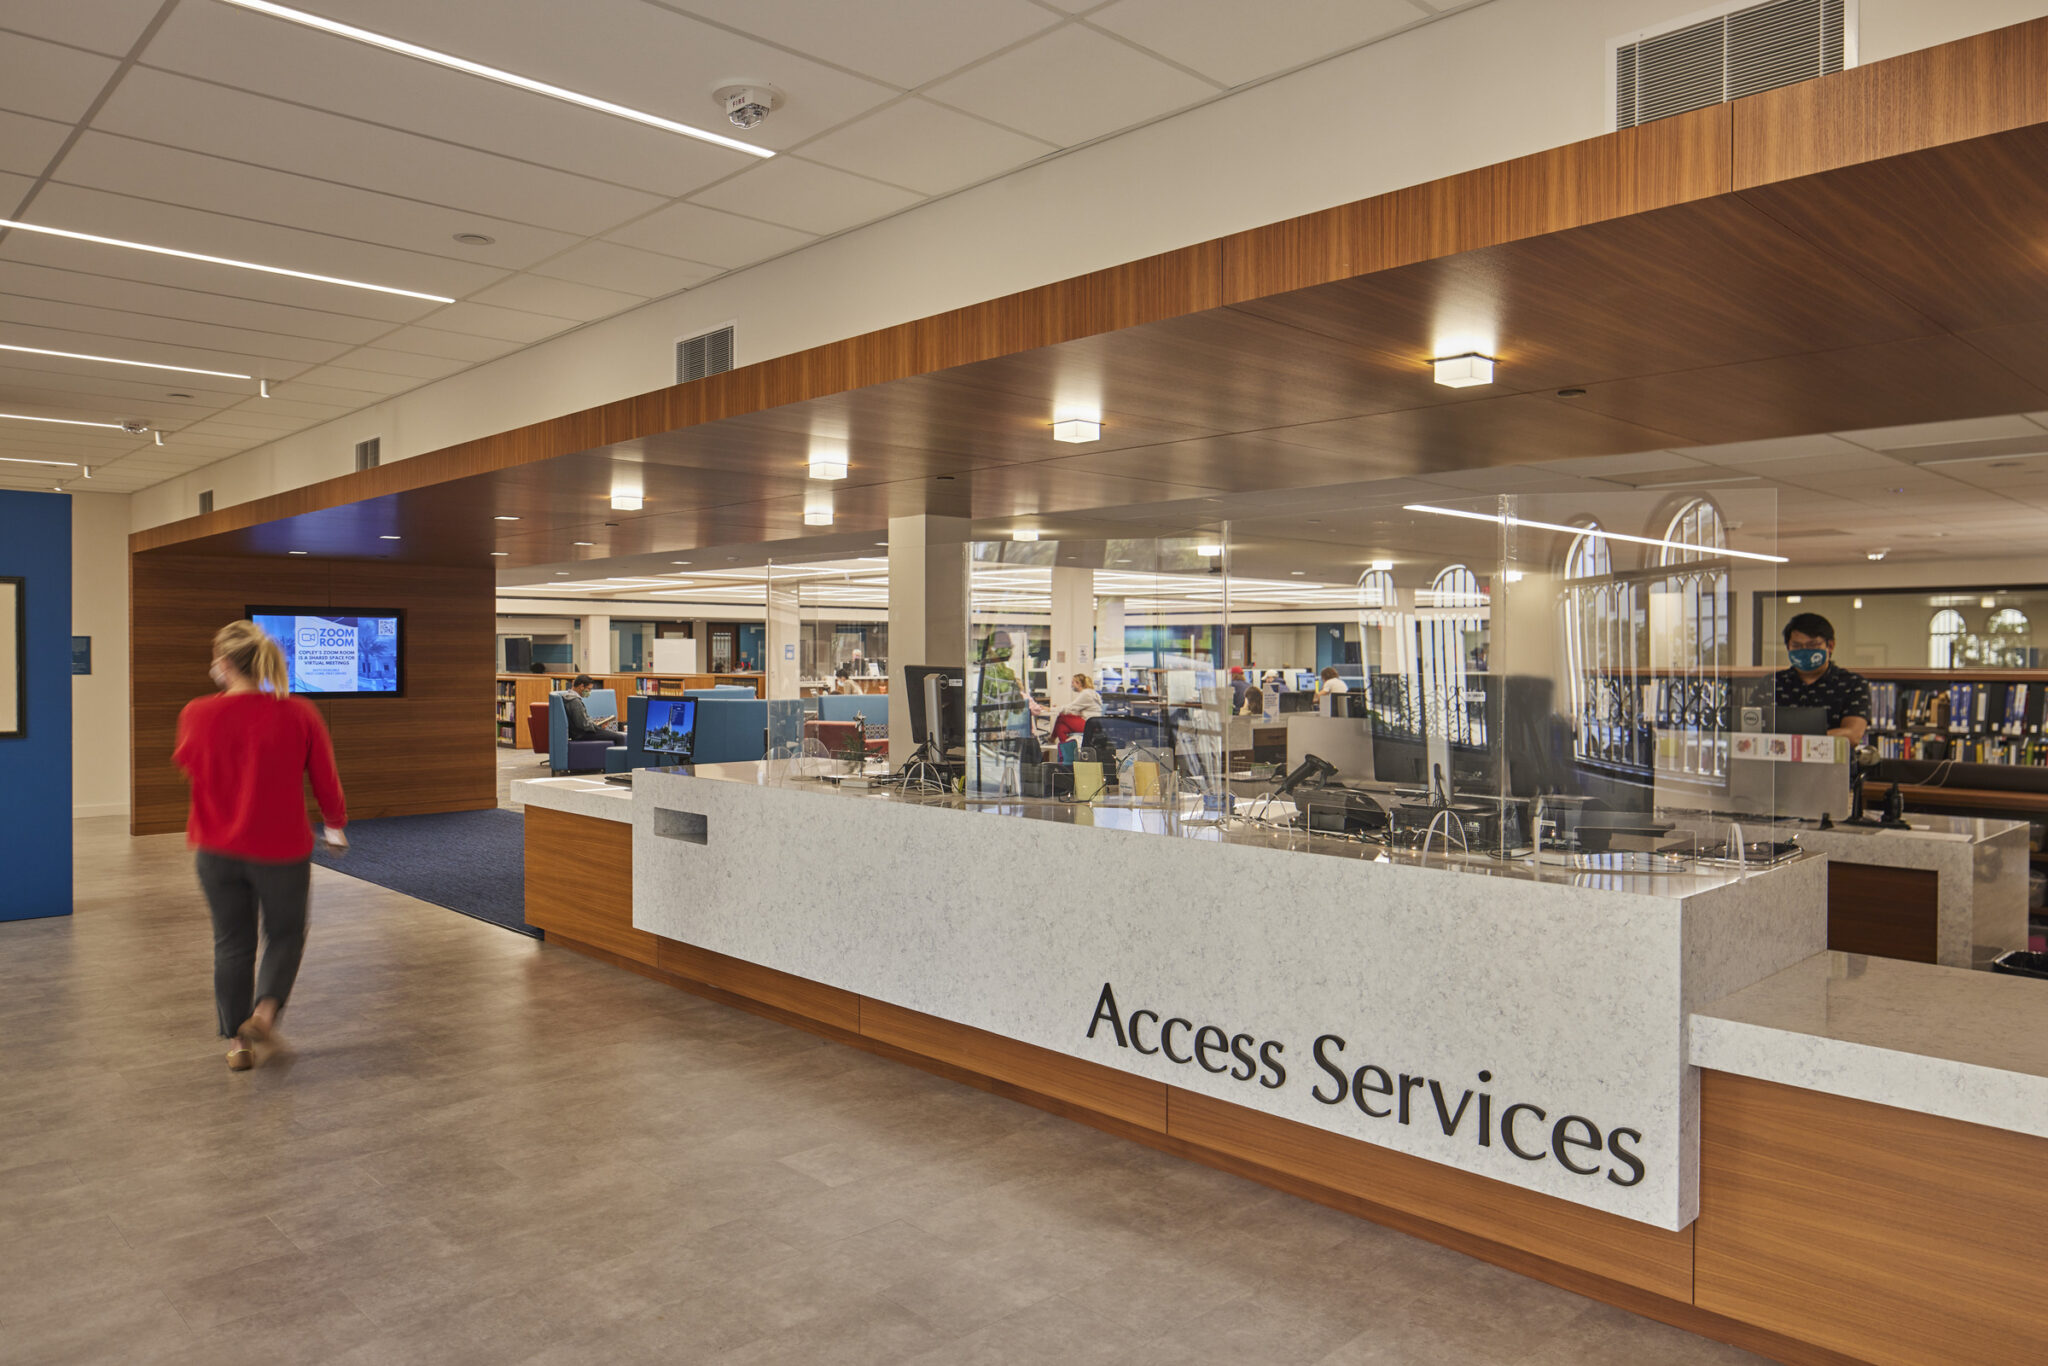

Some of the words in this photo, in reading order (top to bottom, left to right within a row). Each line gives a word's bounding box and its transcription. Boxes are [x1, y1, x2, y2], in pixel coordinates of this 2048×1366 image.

[732, 96, 745, 107] FIRE
[319, 628, 355, 637] ZOOM
[319, 638, 355, 647] ROOM
[1086, 982, 1287, 1090] Access
[1311, 1033, 1646, 1187] Services
